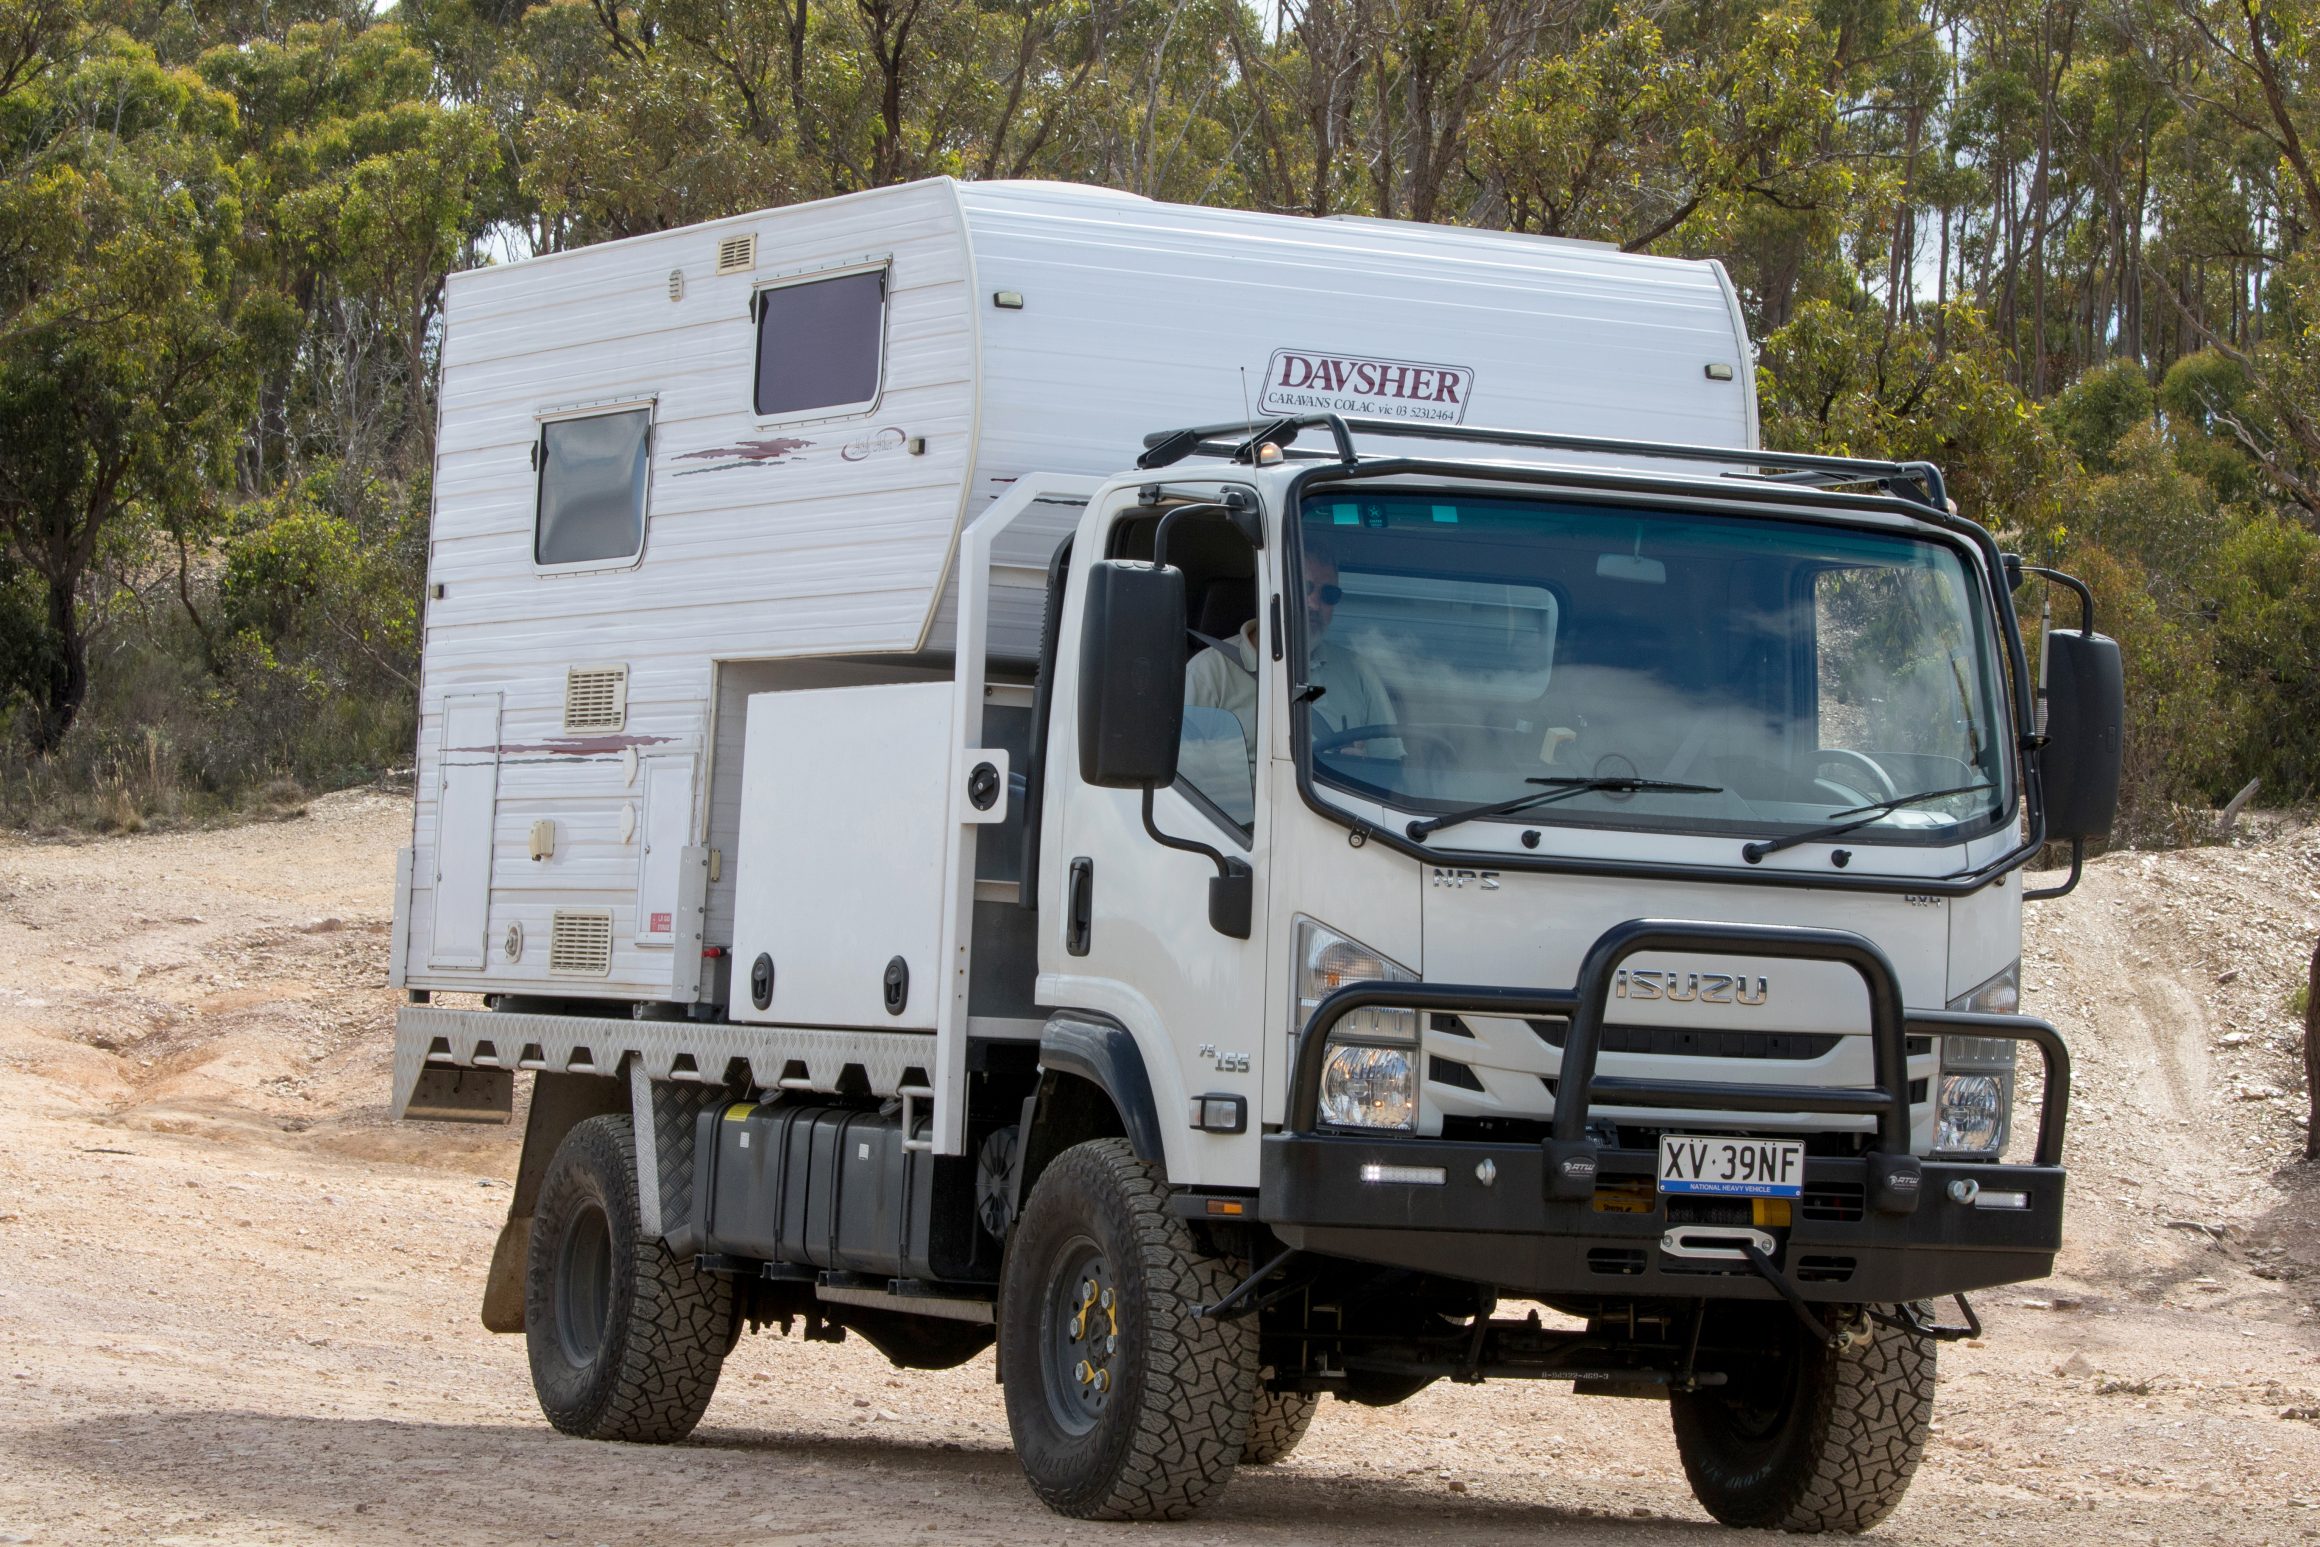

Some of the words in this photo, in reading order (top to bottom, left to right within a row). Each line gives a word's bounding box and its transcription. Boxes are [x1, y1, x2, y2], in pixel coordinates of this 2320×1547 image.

[1278, 355, 1460, 404] DAVSHER
[1268, 392, 1330, 409] CARAVANS
[1334, 398, 1375, 413] COLAC
[1379, 404, 1393, 415] vic
[1396, 405, 1407, 416] 03
[1410, 407, 1454, 421] 52312464
[1433, 868, 1500, 890] NPS
[1616, 969, 1768, 1005] ISUZU
[1215, 1051, 1250, 1073] 155
[1690, 1183, 1721, 1191] NATIONAL
